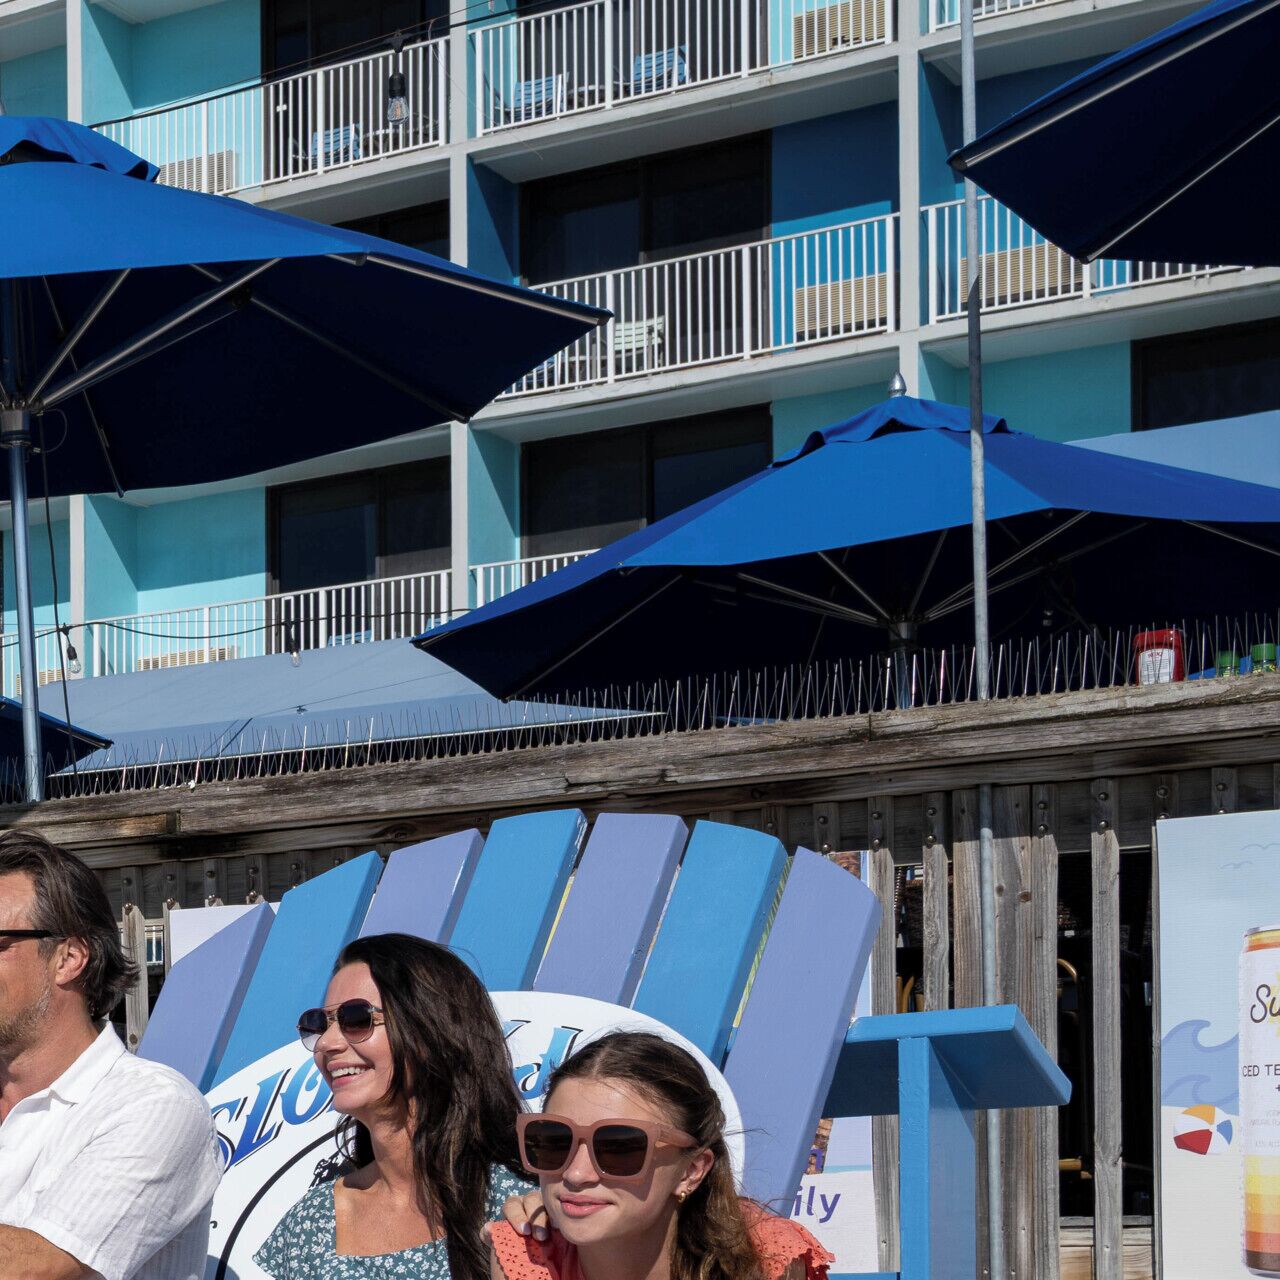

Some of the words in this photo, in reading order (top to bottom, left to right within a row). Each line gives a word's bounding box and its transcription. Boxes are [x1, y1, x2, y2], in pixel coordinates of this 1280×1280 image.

[1242, 1064, 1260, 1078] CED
[1265, 1063, 1280, 1077] TE
[793, 1185, 841, 1224] ily
